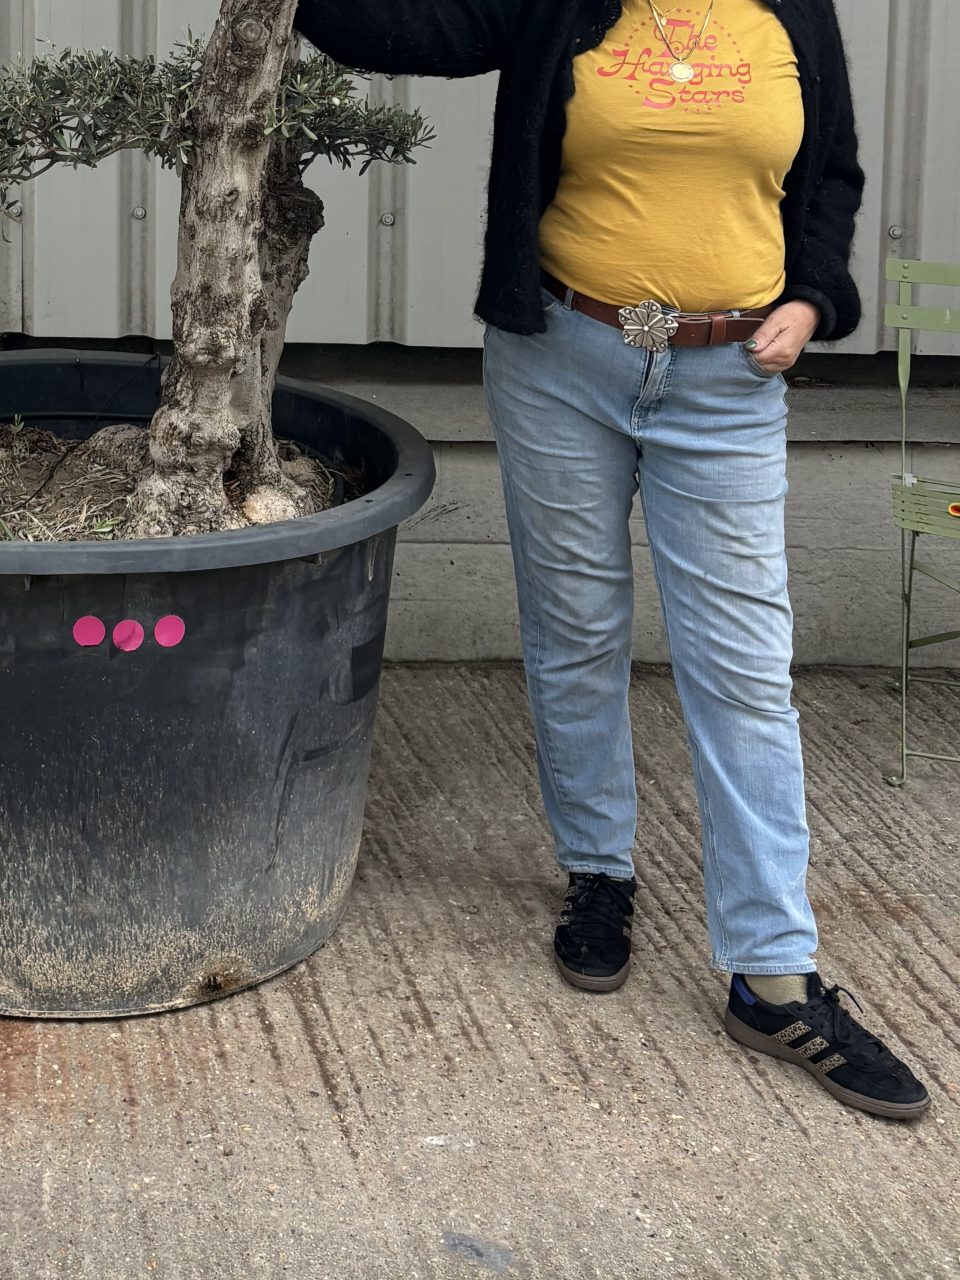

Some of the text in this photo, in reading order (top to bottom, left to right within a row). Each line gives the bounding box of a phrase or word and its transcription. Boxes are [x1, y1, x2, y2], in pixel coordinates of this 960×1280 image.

[653, 18, 717, 57] The
[596, 47, 752, 85] Haging
[642, 77, 745, 109] Stars
